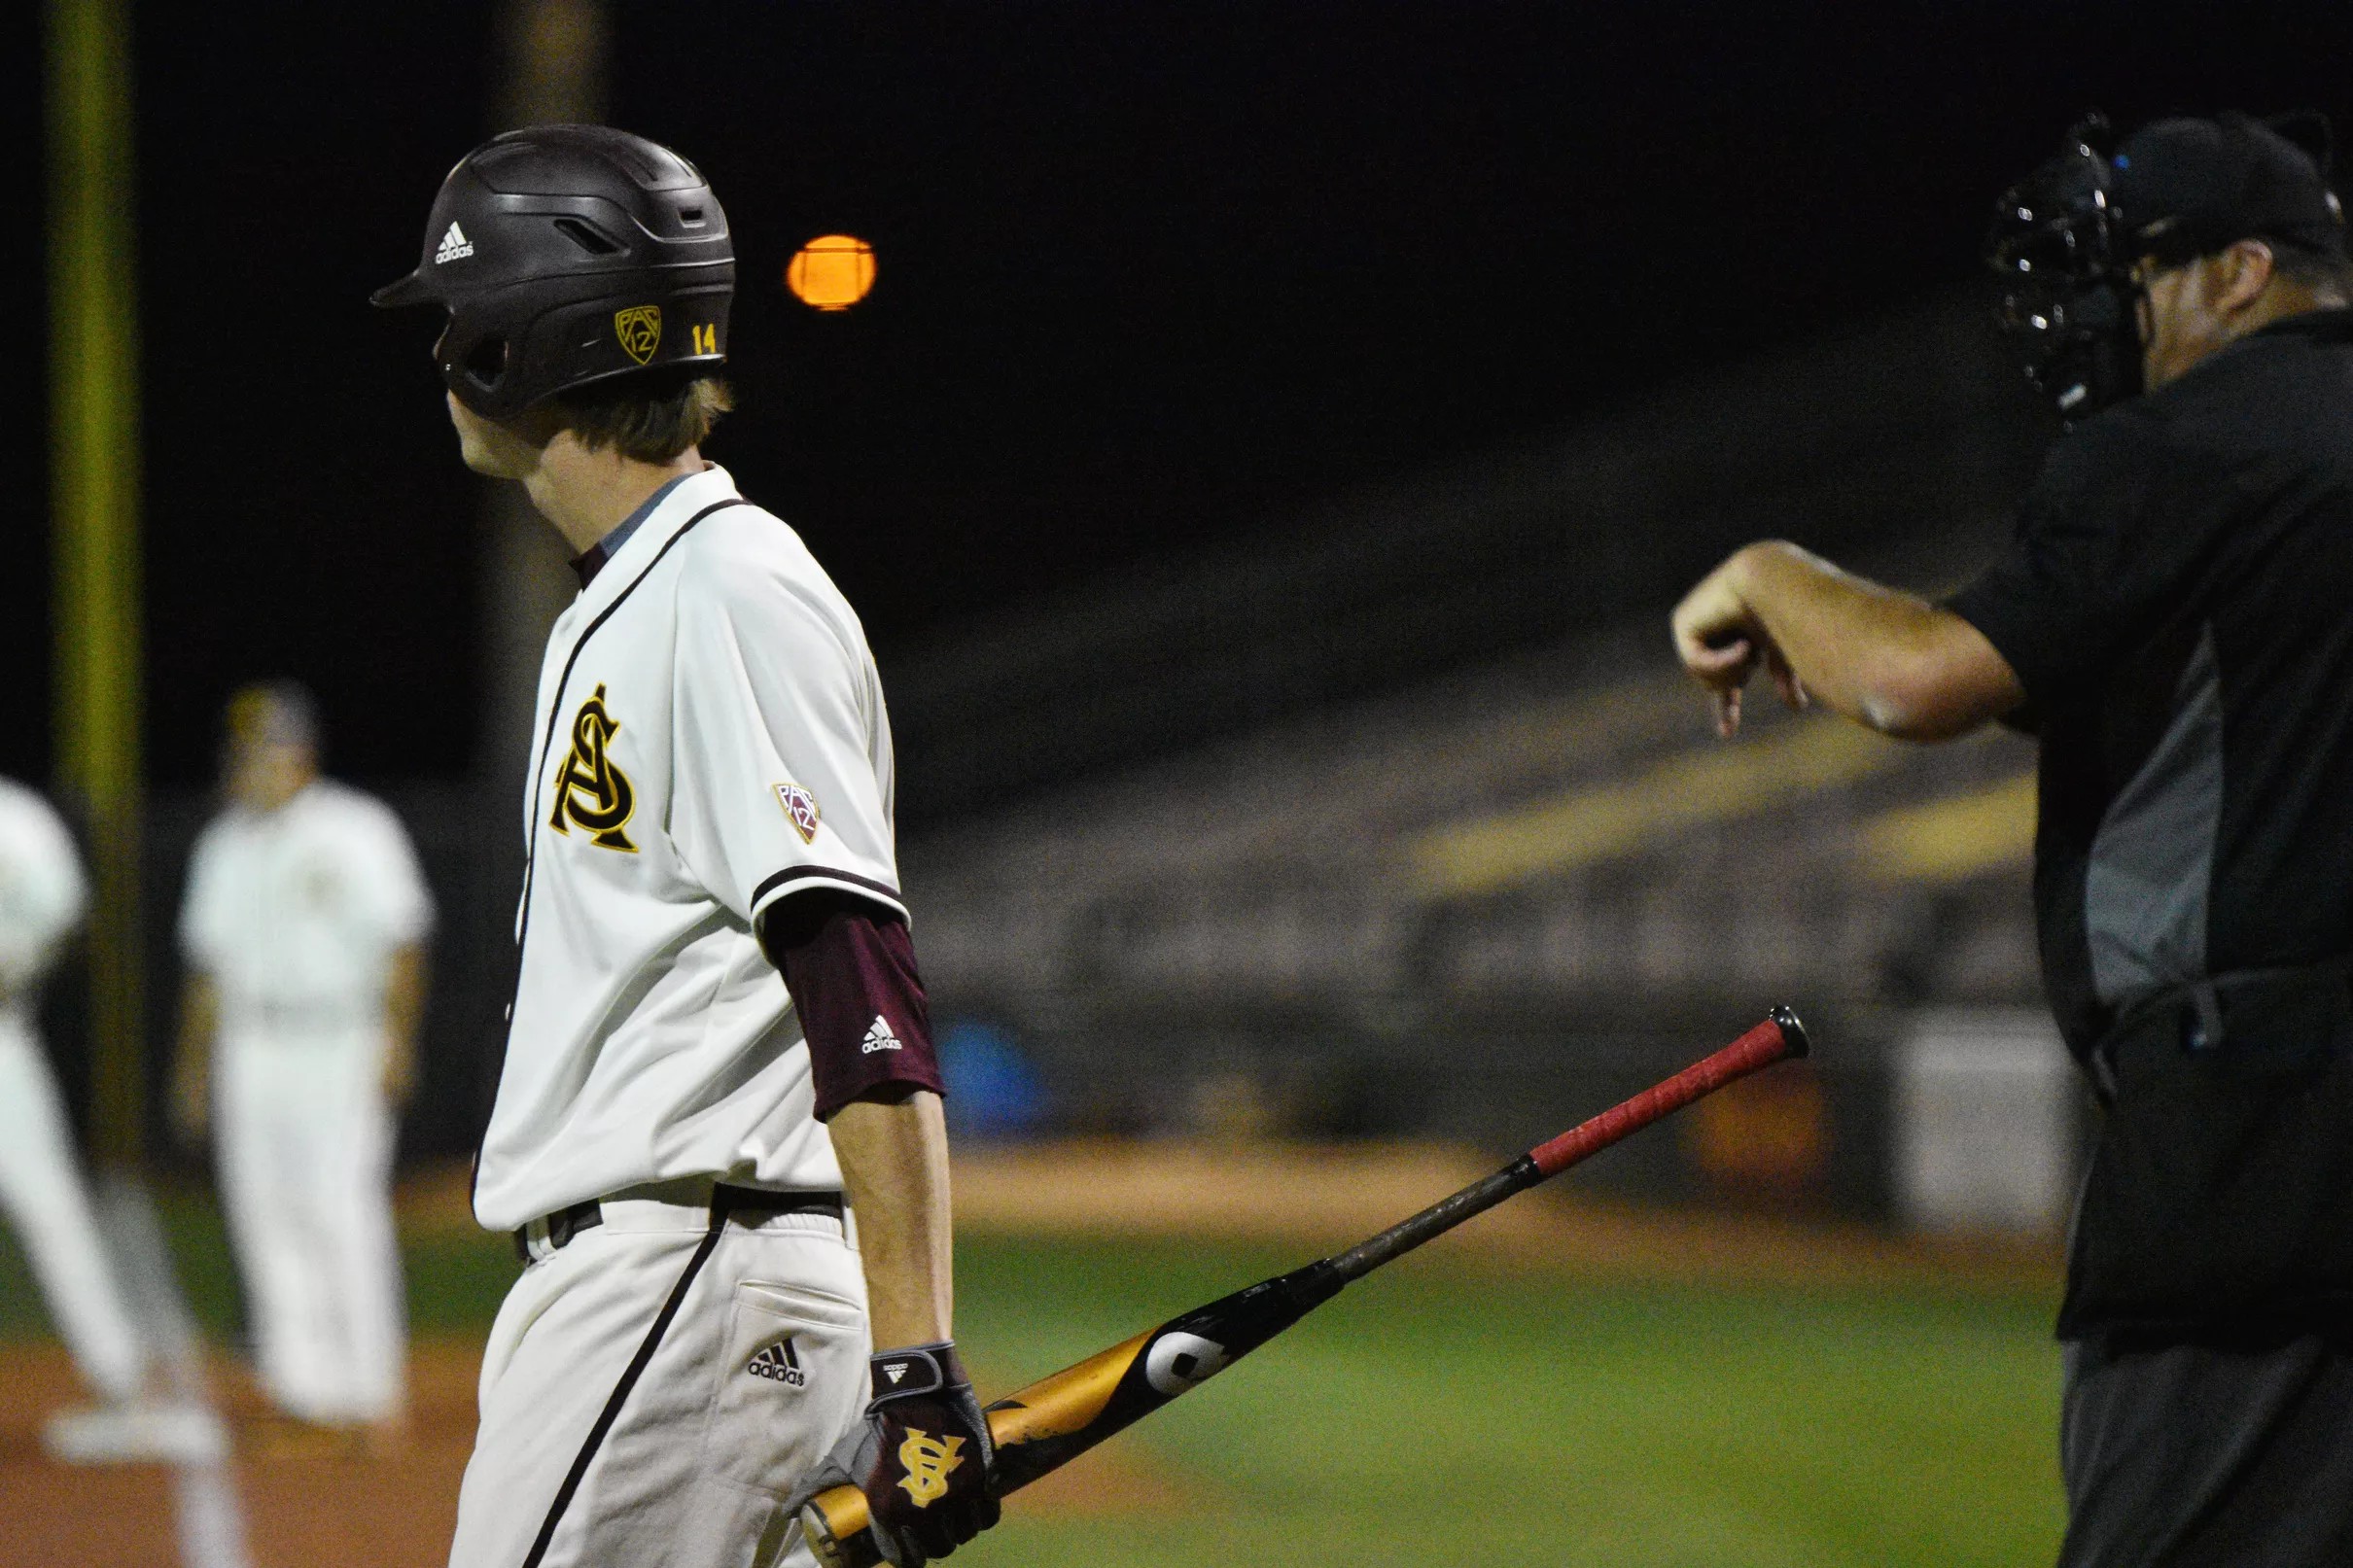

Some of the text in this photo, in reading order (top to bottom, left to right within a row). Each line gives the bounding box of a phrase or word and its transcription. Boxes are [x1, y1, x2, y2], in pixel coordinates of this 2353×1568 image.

[436, 244, 474, 264] adidas
[619, 308, 660, 341] PAC
[631, 331, 652, 353] 12
[692, 323, 716, 355] 14
[778, 784, 817, 821] PAC
[793, 806, 816, 831] 12
[861, 1037, 902, 1054] adidas
[748, 1362, 804, 1387] adidas
